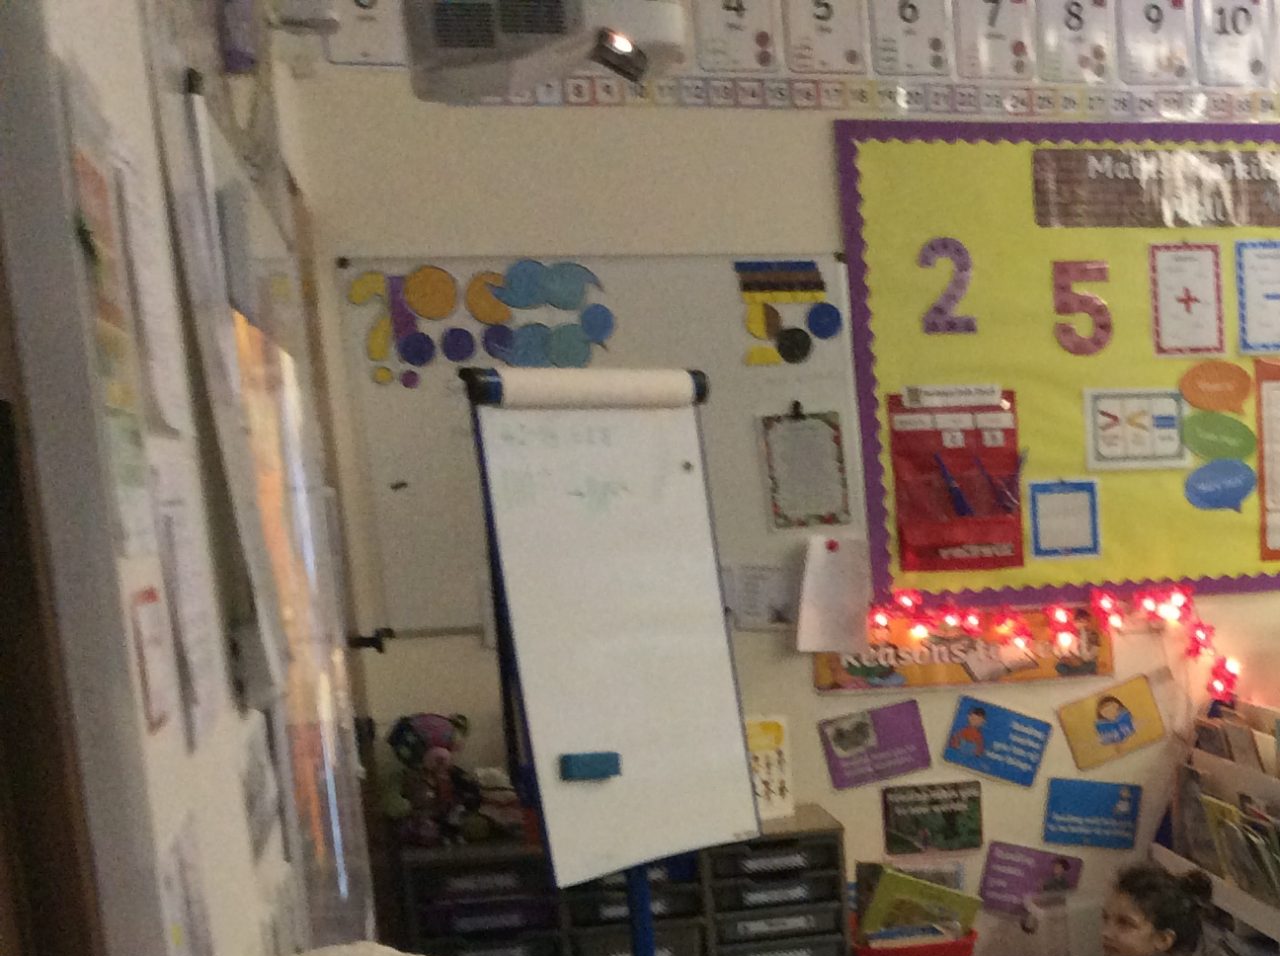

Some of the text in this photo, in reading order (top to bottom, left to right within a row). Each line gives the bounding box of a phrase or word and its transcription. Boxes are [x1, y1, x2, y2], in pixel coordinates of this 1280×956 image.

[811, 0, 833, 20] 5
[899, 0, 920, 24] 6
[984, 0, 1000, 30] 7
[1065, 0, 1085, 32] 8
[1145, 3, 1165, 35] 9
[1214, 6, 1252, 37] 10
[916, 236, 978, 335] 2
[1051, 261, 1114, 356] 5
